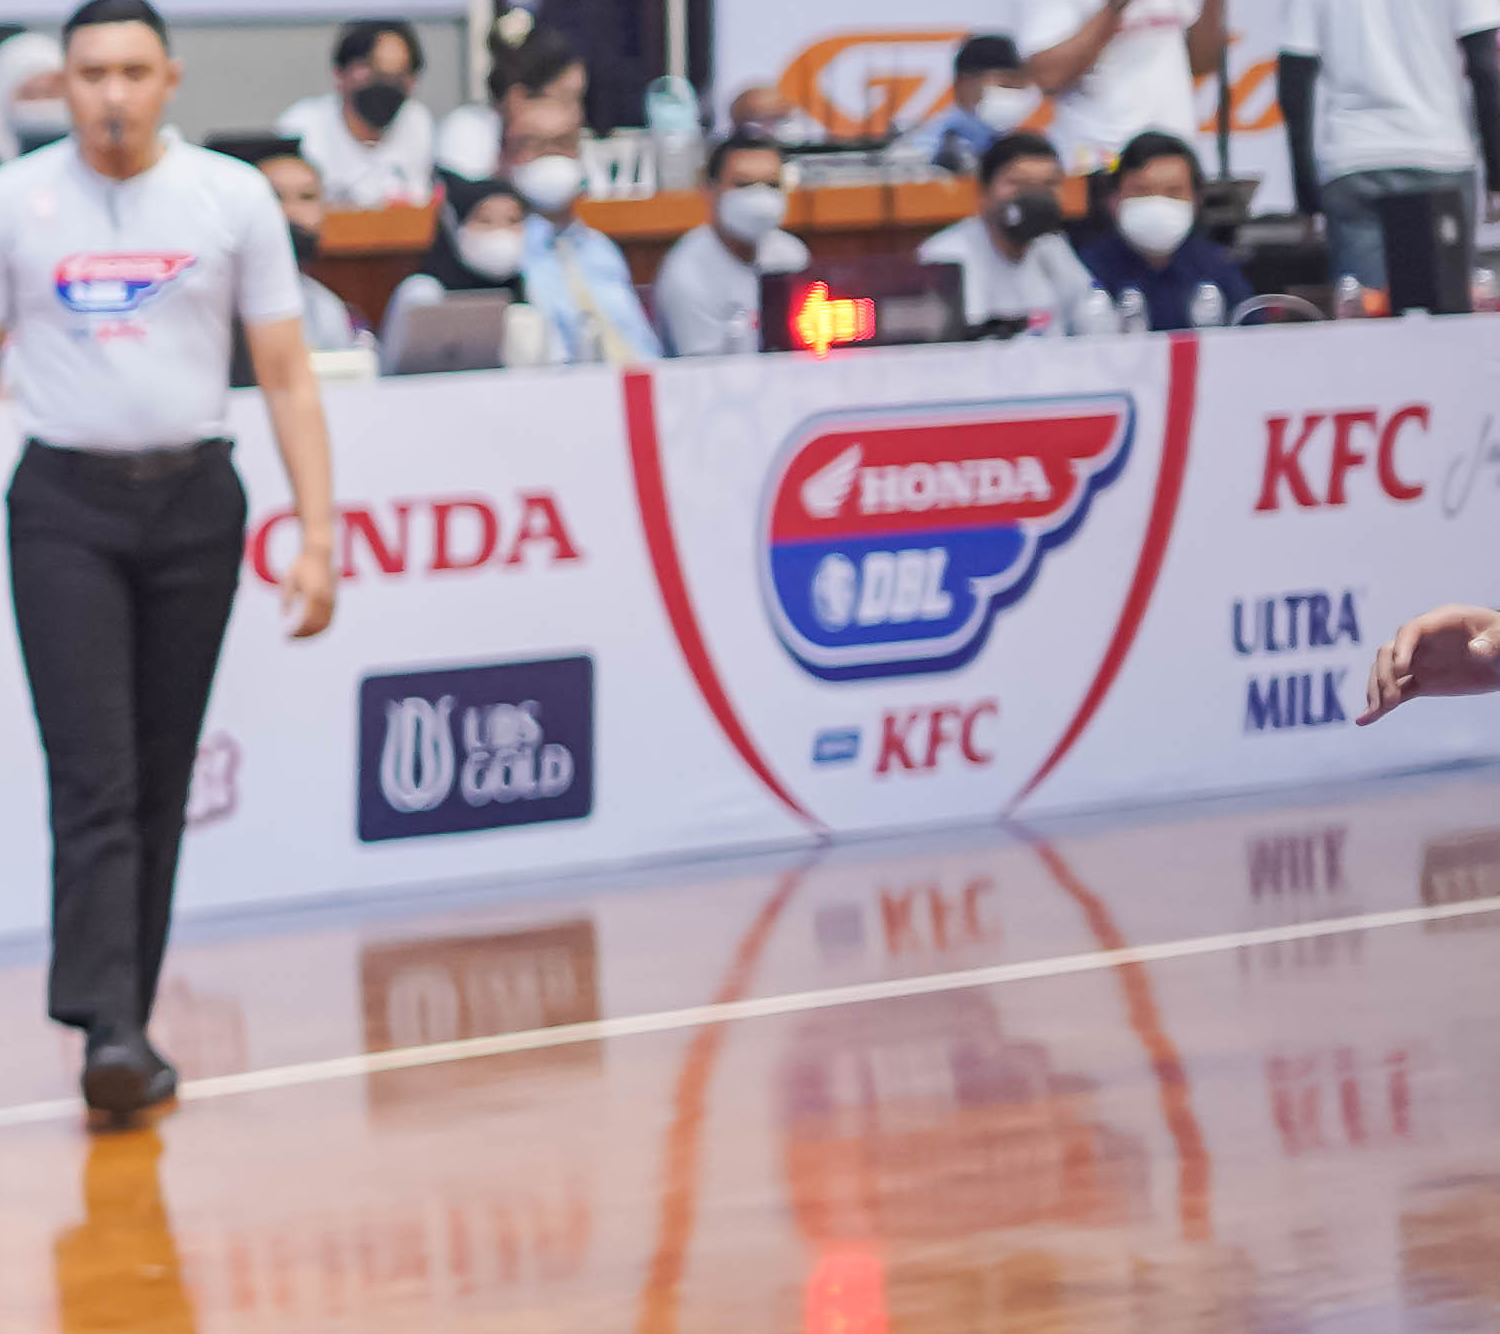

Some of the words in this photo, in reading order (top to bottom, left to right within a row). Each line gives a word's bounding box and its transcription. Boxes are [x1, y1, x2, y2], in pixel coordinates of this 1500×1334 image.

[859, 455, 1052, 515] HONDA
[1252, 404, 1432, 512] KFC
[244, 494, 584, 586] ONDA
[1232, 588, 1363, 656] ULTRA
[1244, 668, 1349, 732] MILK
[874, 698, 1000, 777] KFC
